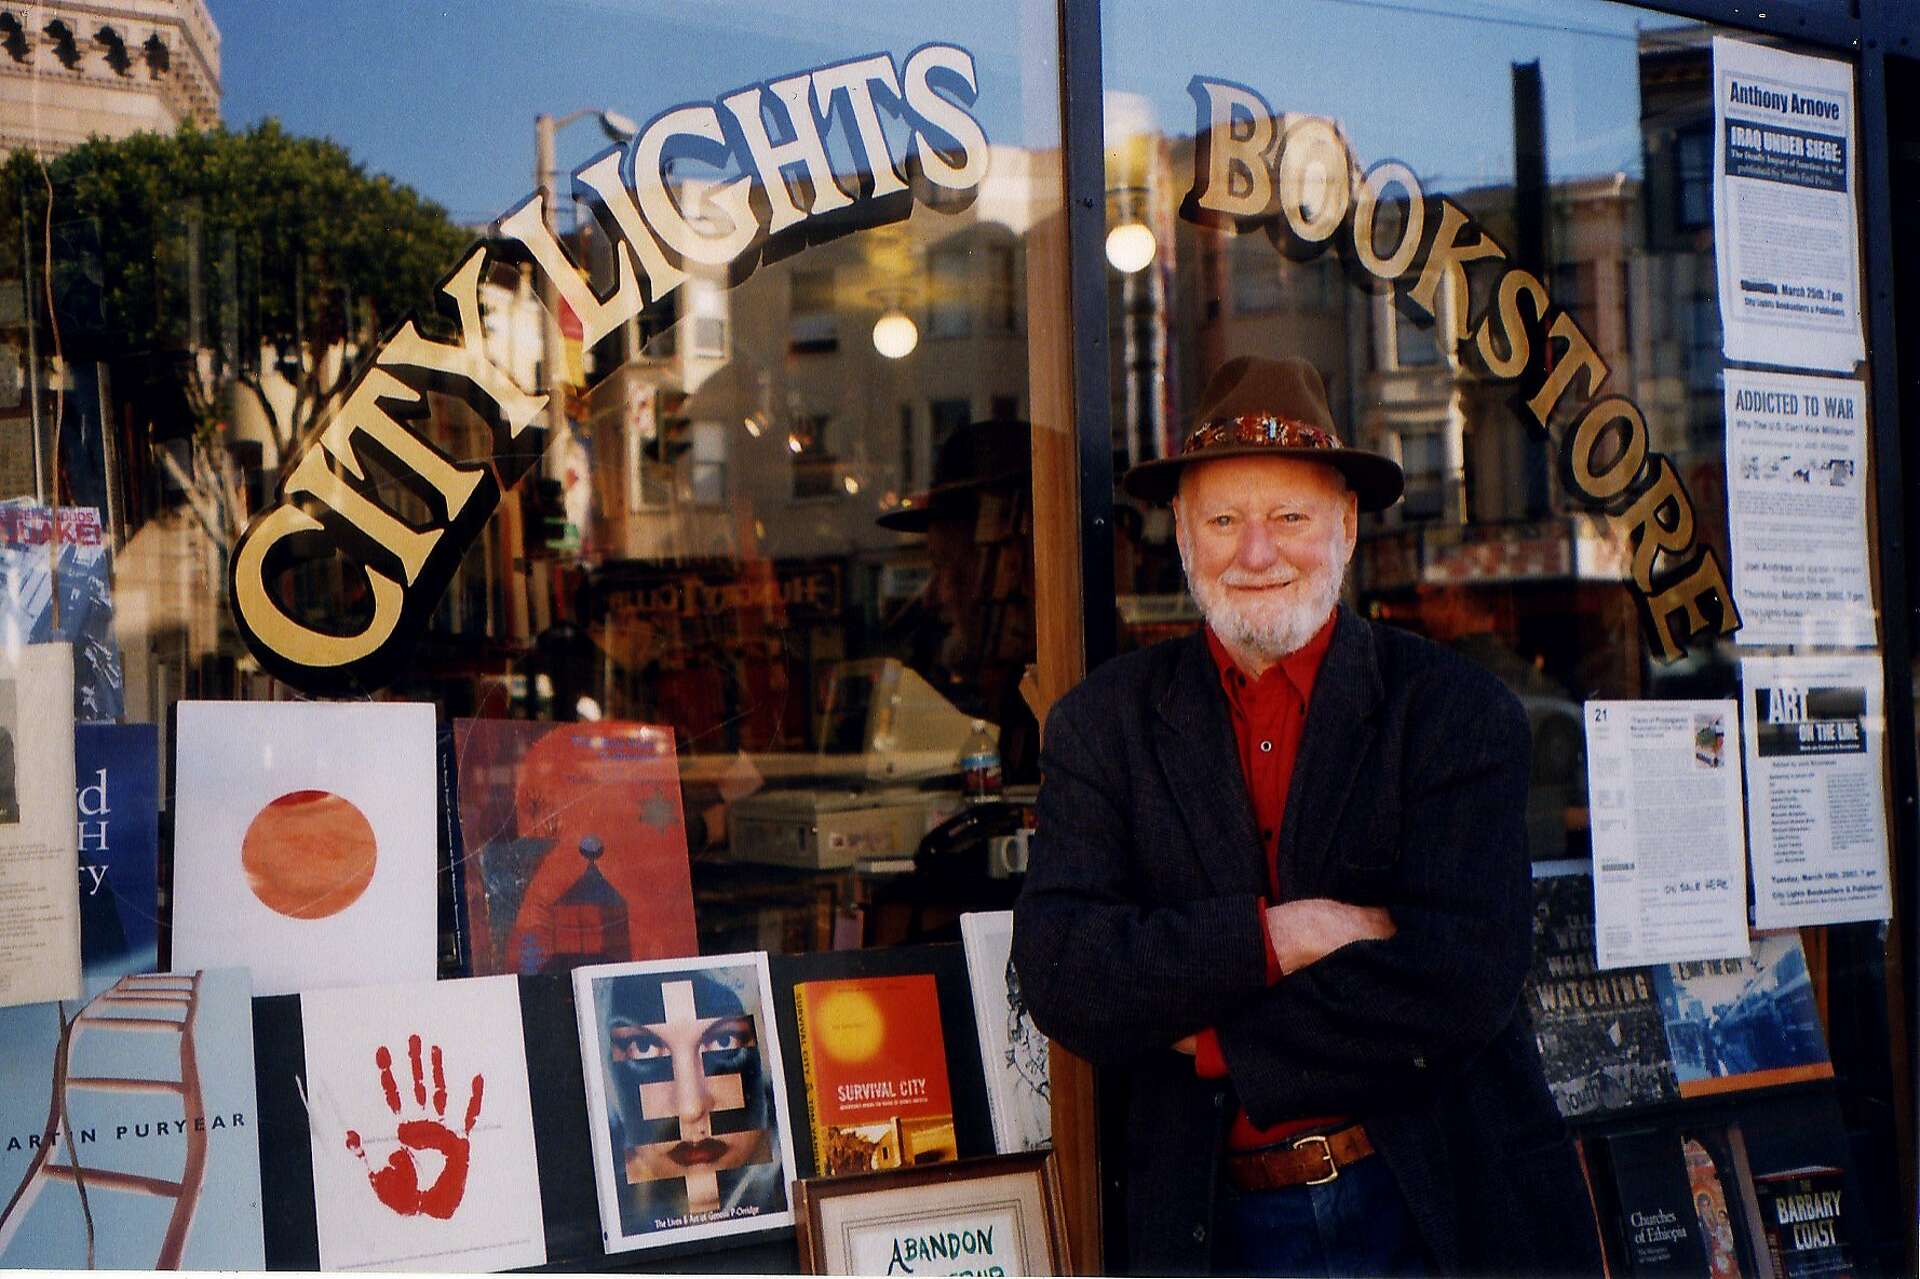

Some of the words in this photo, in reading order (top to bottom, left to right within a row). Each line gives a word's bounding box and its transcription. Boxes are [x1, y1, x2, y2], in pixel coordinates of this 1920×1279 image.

[1730, 81, 1788, 114] Anthony
[1791, 93, 1840, 120] Arnove
[1731, 126, 1762, 151] IRAQ
[1763, 131, 1805, 157] UNDER
[1805, 138, 1841, 162] SIEGE:
[232, 243, 551, 680] CITY
[498, 42, 991, 358] LIGHTS
[1180, 75, 1743, 664] BOOKSTORE
[1735, 389, 1798, 416] ADDICTED
[1803, 395, 1819, 417] TO
[1824, 396, 1854, 420] WAR
[1595, 708, 1608, 722] 21
[1769, 687, 1808, 724] ART
[1816, 721, 1836, 741] THE
[1664, 885, 1677, 895] ON
[1680, 881, 1700, 892] SALE
[1705, 879, 1728, 890] HERE
[1536, 973, 1649, 1010] WATCHING
[796, 993, 806, 1048] SURVIVAL
[837, 1082, 897, 1102] SURVIVAL
[900, 1078, 926, 1097] CITY
[117, 1113, 245, 1140] PURYEAR
[1631, 1208, 1677, 1228] Churches
[1776, 1190, 1841, 1224] BARBARY
[655, 1219, 666, 1230] The
[1635, 1228, 1646, 1244] of
[1793, 1219, 1837, 1250] COAST
[887, 1225, 993, 1277] ABANDON
